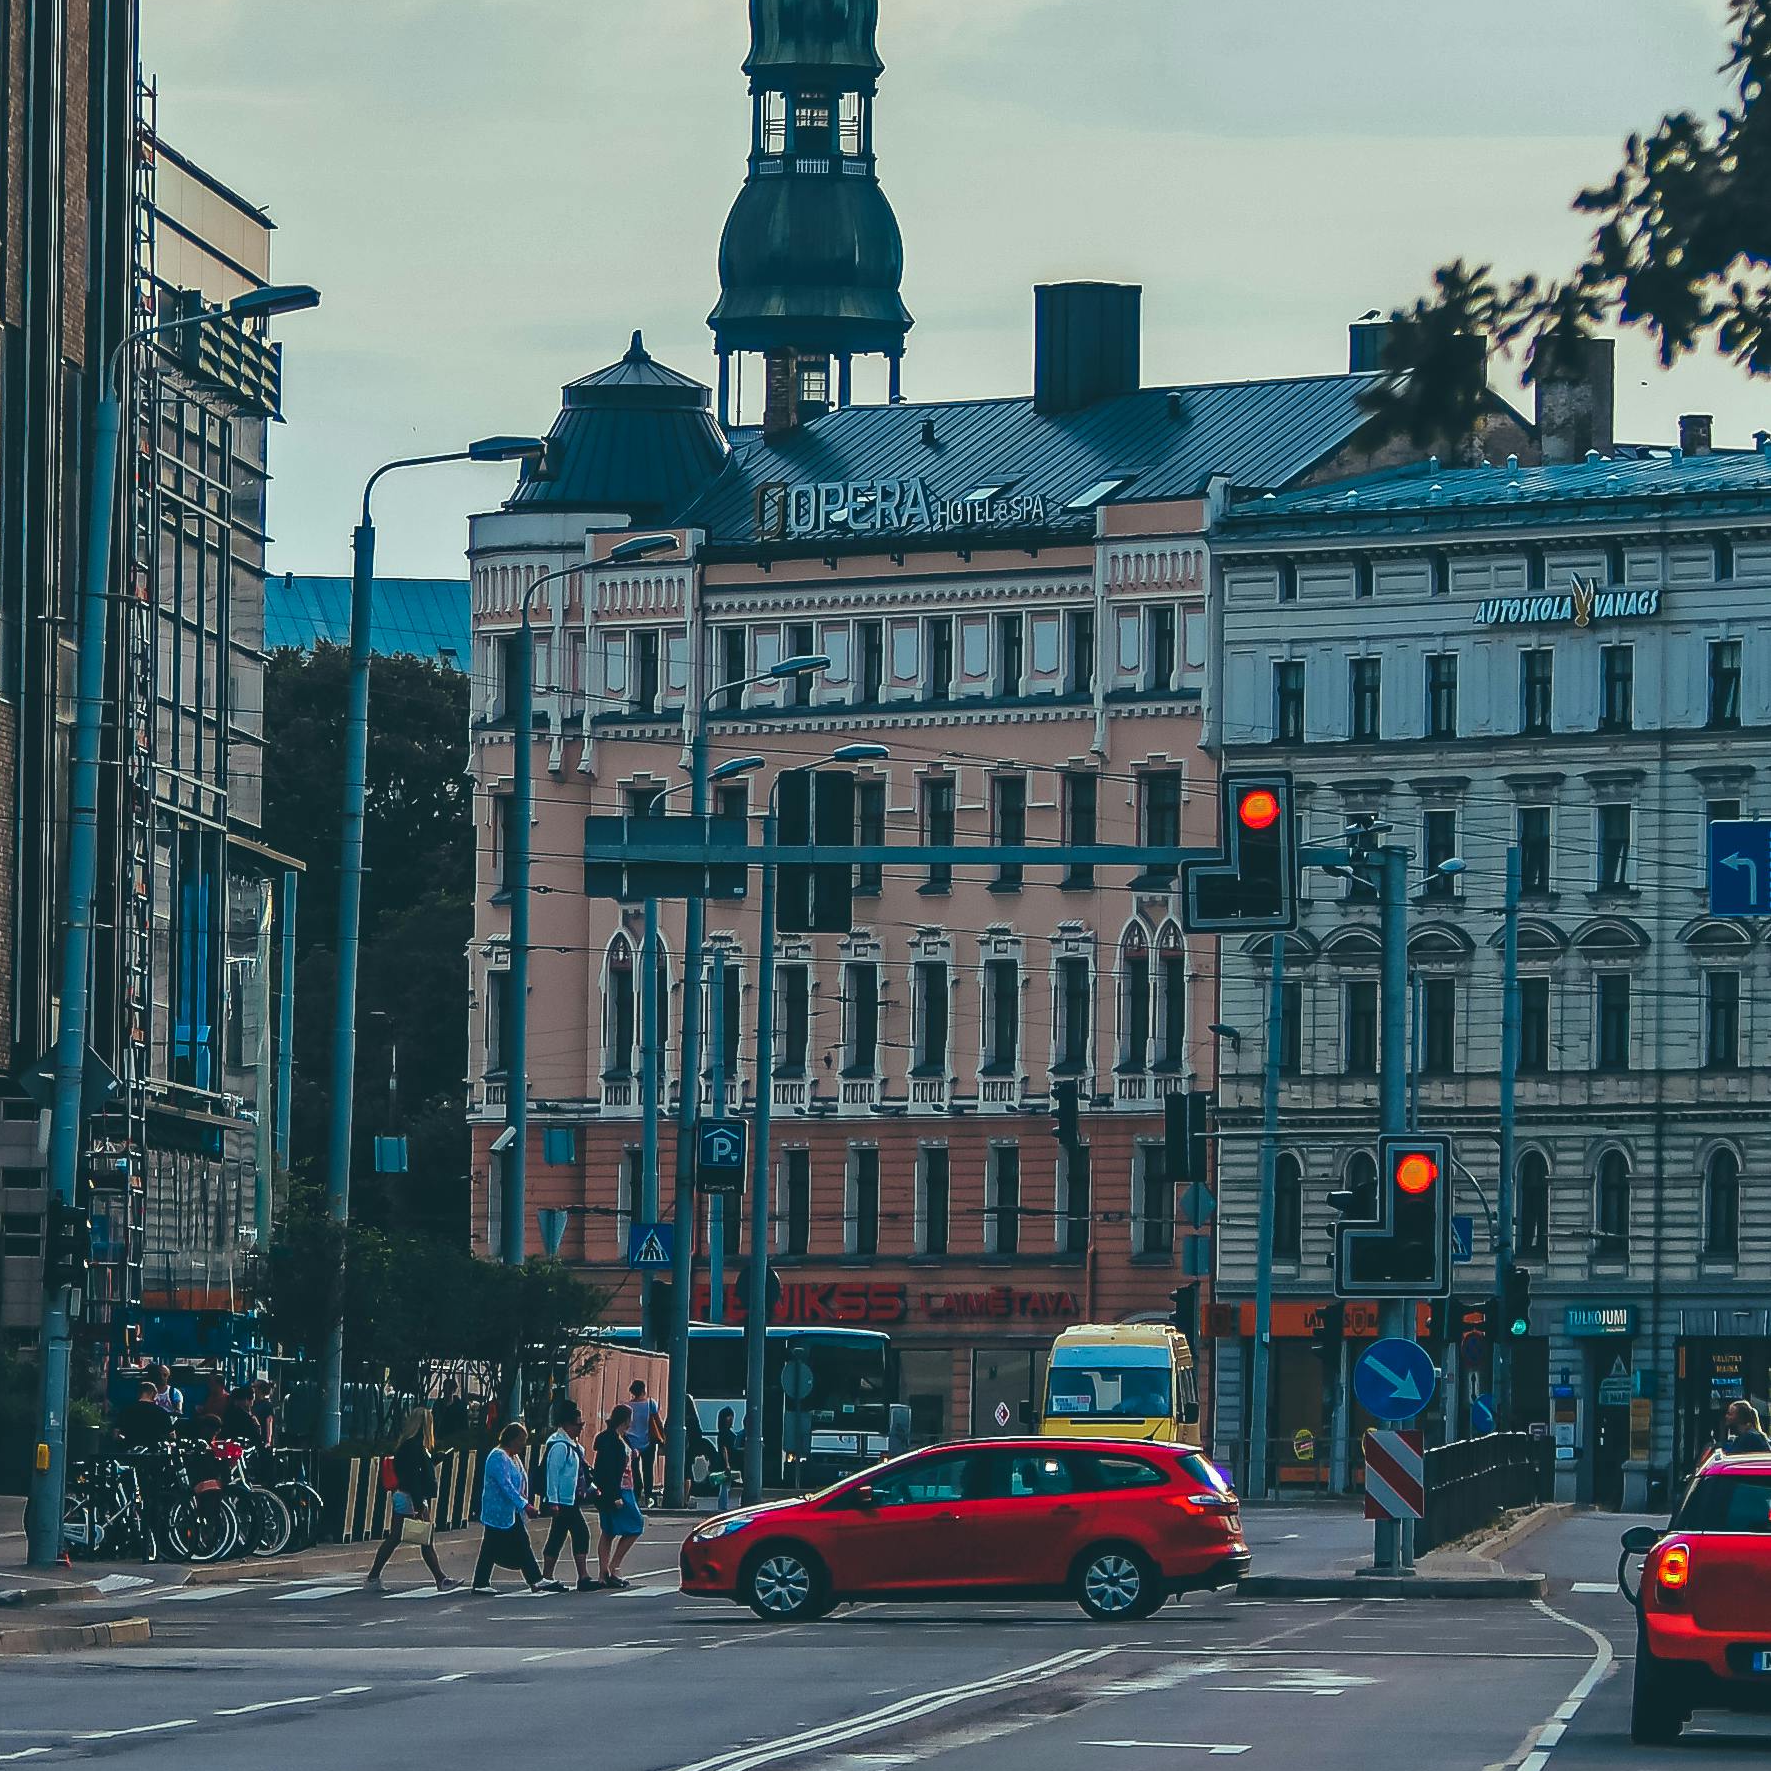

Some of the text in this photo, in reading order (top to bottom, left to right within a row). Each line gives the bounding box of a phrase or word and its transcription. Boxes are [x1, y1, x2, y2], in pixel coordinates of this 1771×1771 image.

[790, 478, 929, 531] OPERA
[938, 497, 995, 525] HOTEL
[1012, 493, 1045, 521] SPA
[1474, 590, 1659, 623] AUTOSKOLA VANAGS
[712, 1137, 732, 1162] P
[1568, 1308, 1627, 1326] TULKOJUMI
